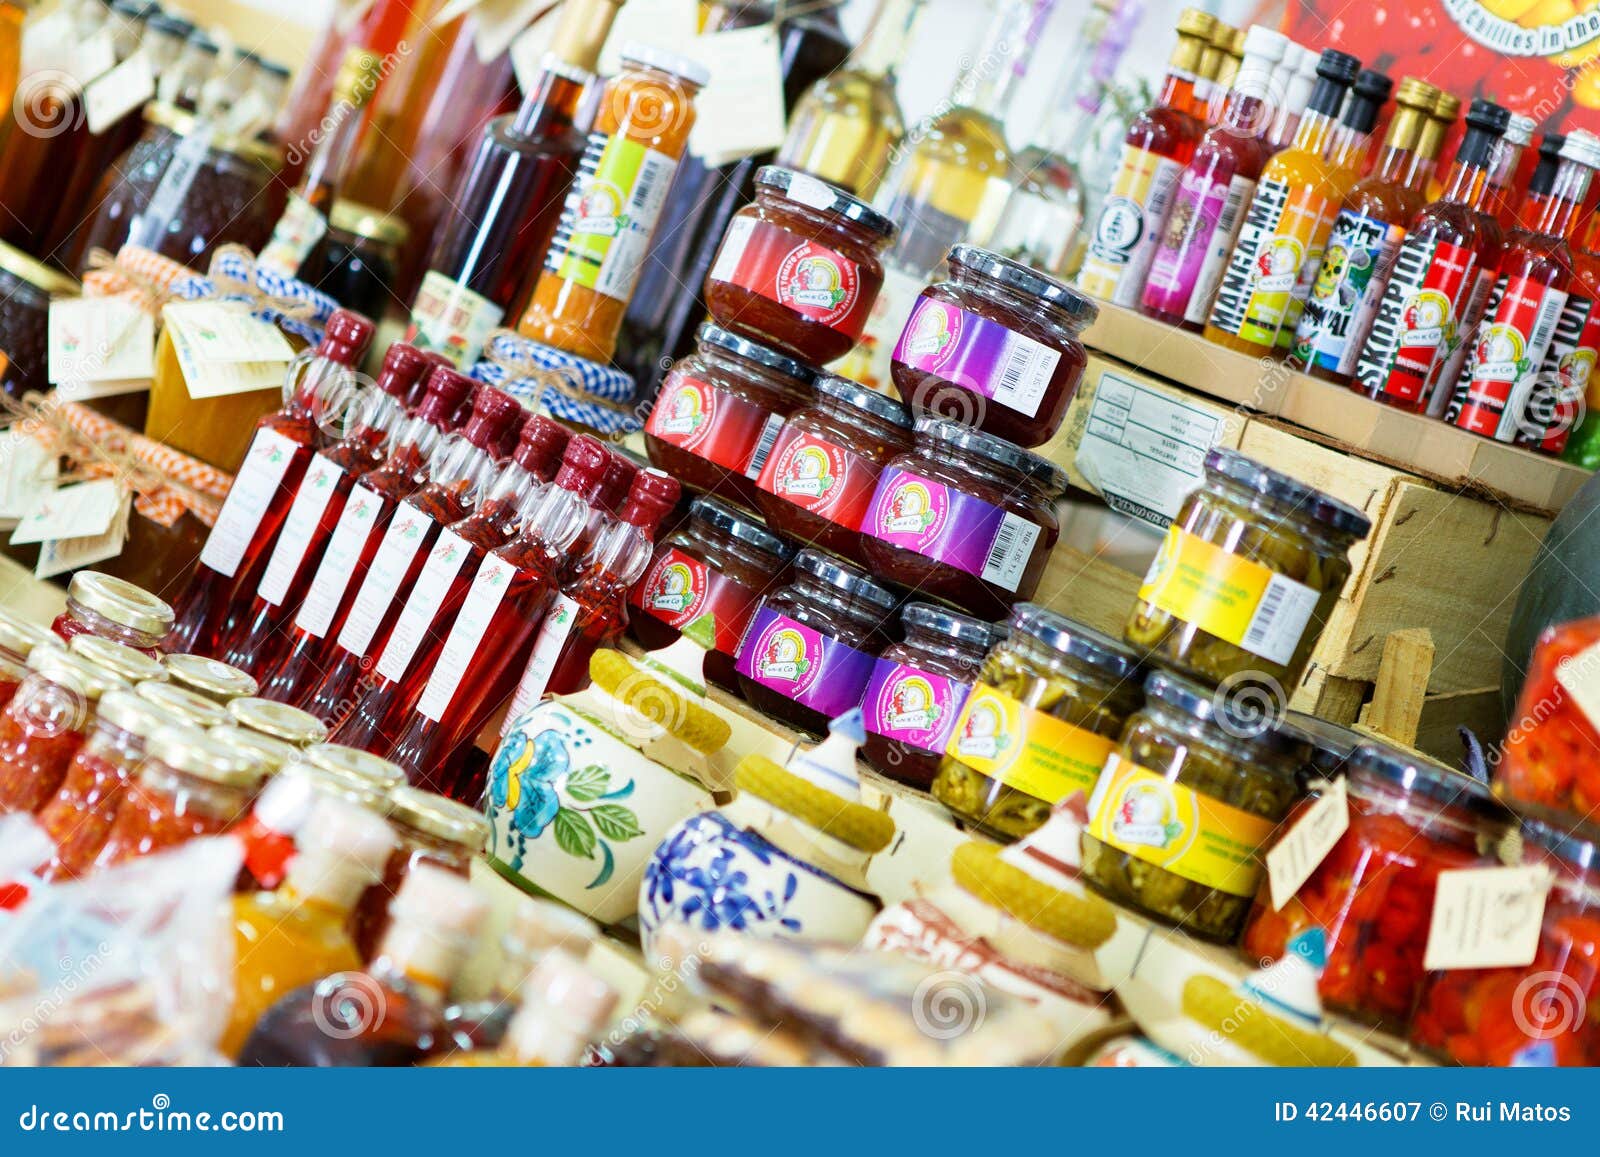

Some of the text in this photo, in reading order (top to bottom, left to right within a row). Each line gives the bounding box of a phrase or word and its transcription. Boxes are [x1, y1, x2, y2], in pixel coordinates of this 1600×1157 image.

[1466, 8, 1600, 49] Chillies in the
[1357, 231, 1434, 394] SKORPION
